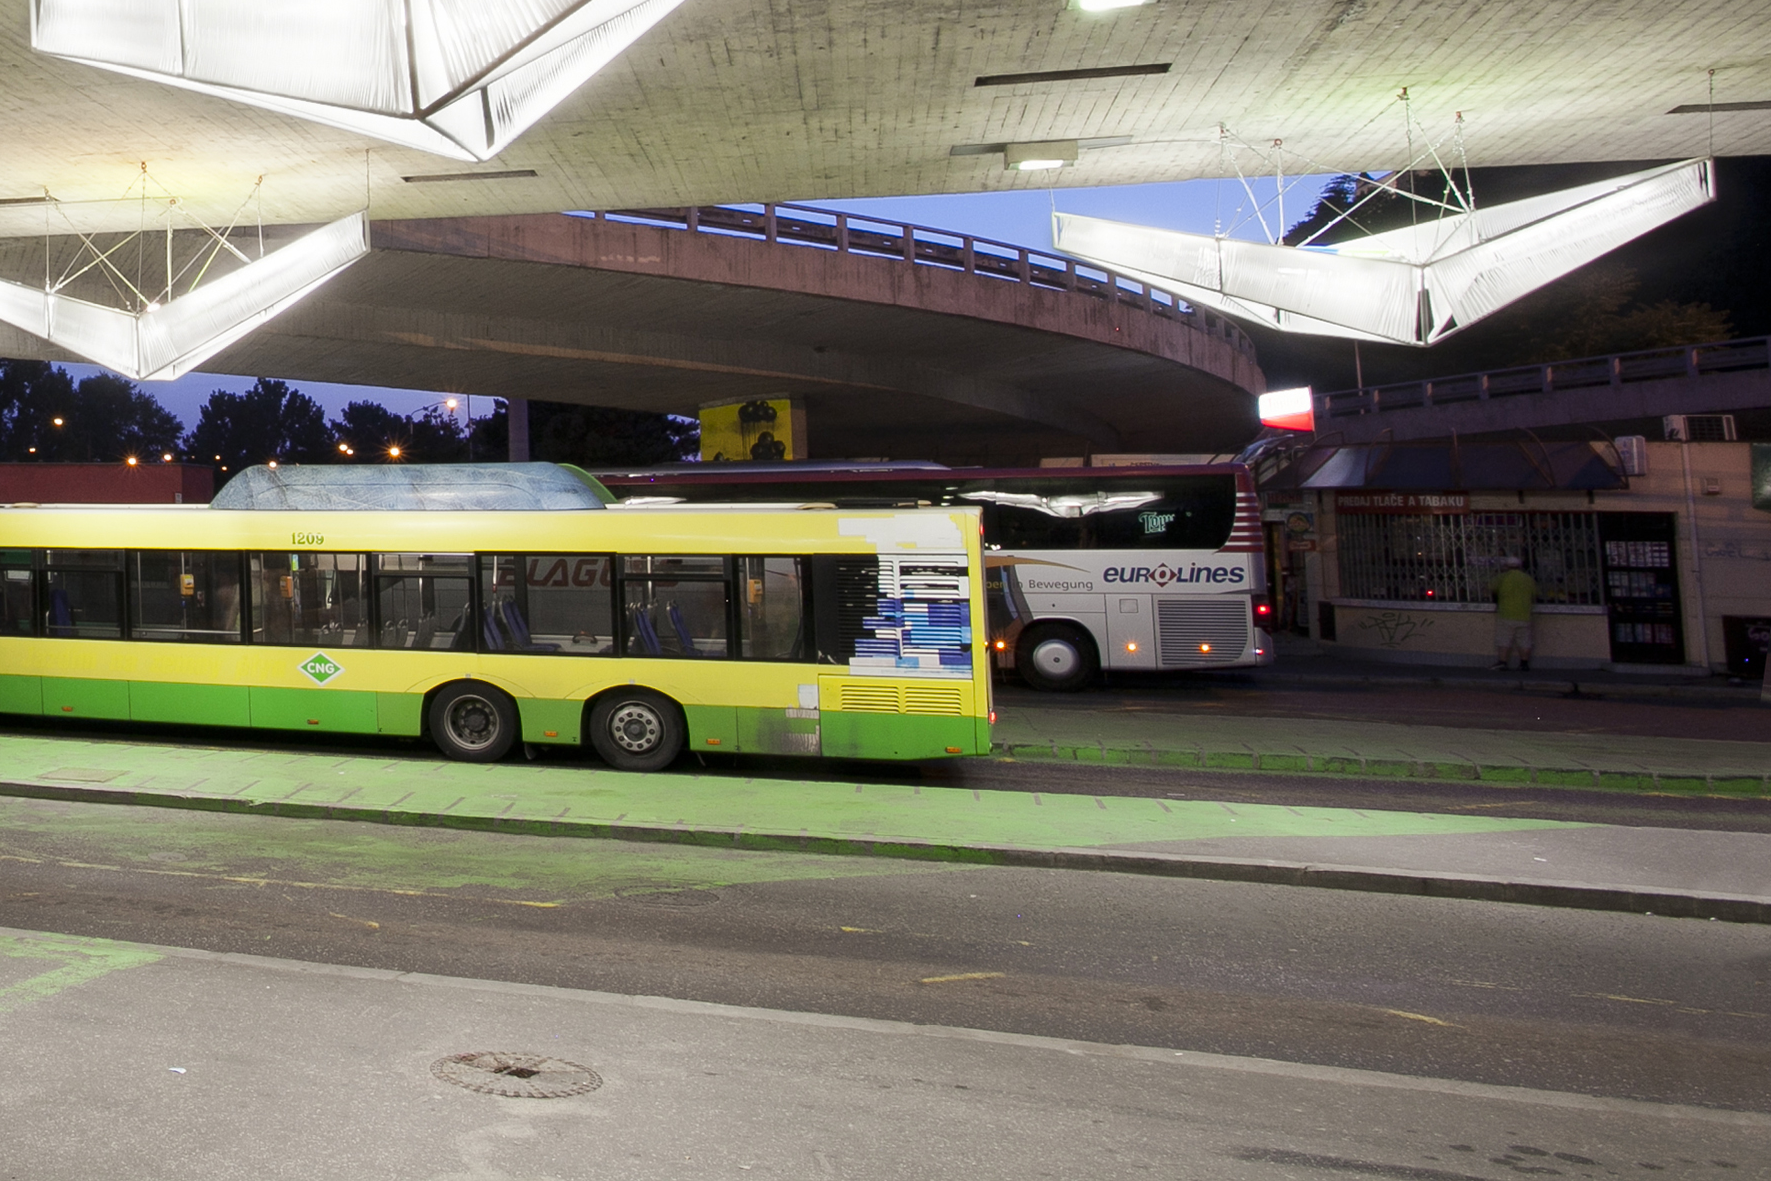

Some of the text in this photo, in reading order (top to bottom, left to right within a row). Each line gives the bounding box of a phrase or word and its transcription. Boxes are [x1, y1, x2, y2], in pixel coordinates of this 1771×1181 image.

[1338, 493, 1464, 507] PREDAJ TLAČE A TABAKU
[291, 532, 325, 545] 1209
[1029, 579, 1093, 592] Bewegung
[306, 662, 335, 675] CNG
